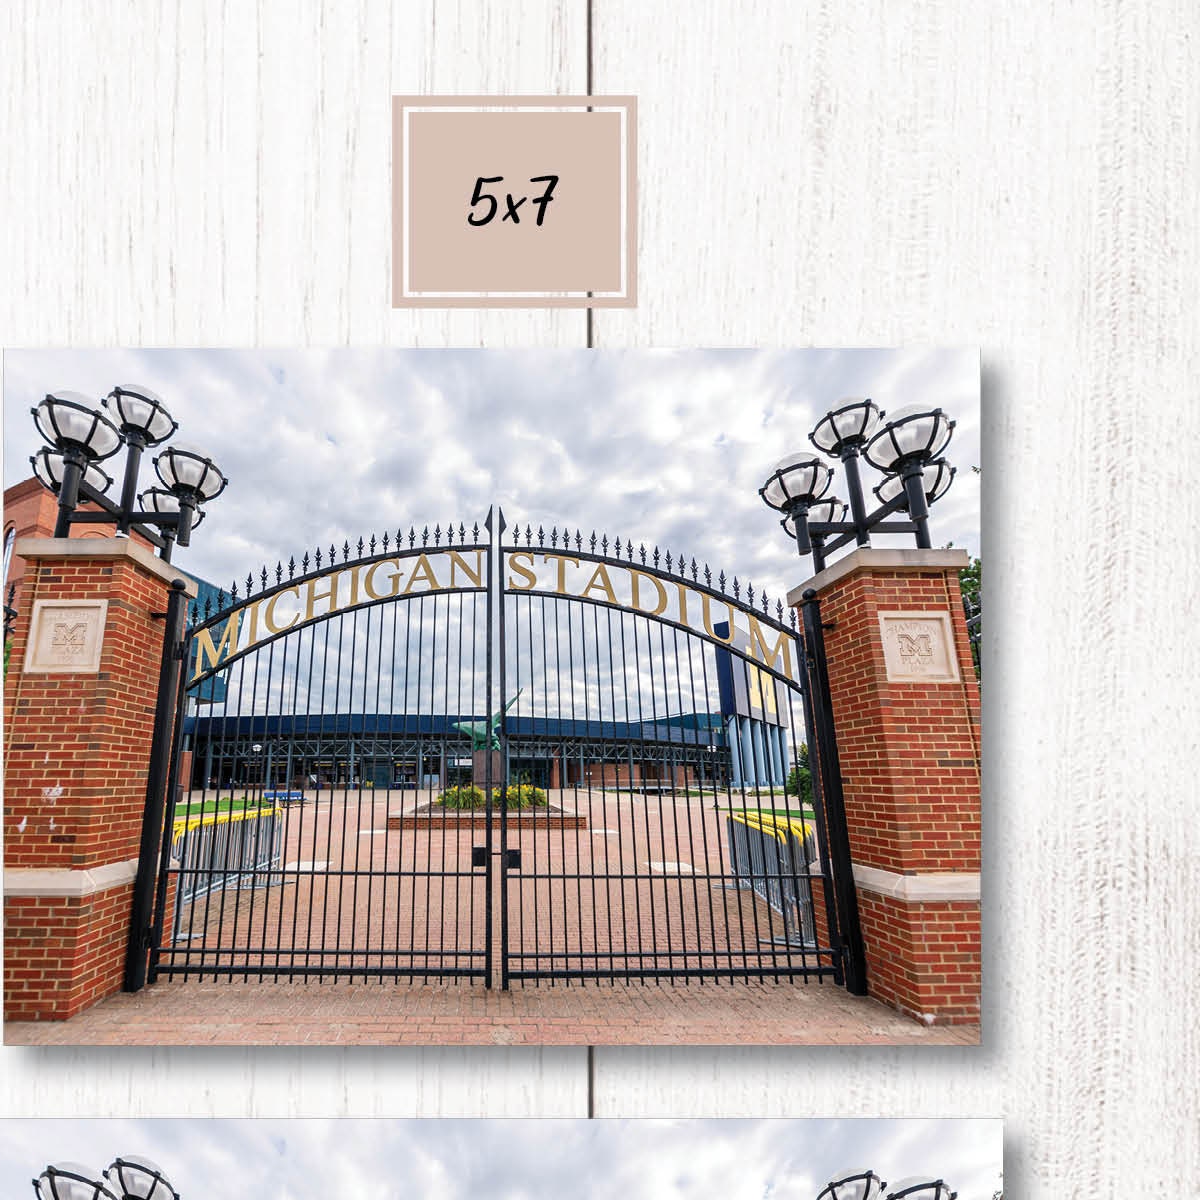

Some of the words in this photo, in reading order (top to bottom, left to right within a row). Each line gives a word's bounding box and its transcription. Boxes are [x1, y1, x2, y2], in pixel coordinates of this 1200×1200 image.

[190, 549, 487, 683] MICHIGAN
[508, 552, 793, 681] STADIUM
[52, 623, 88, 646] M
[897, 633, 933, 657] M
